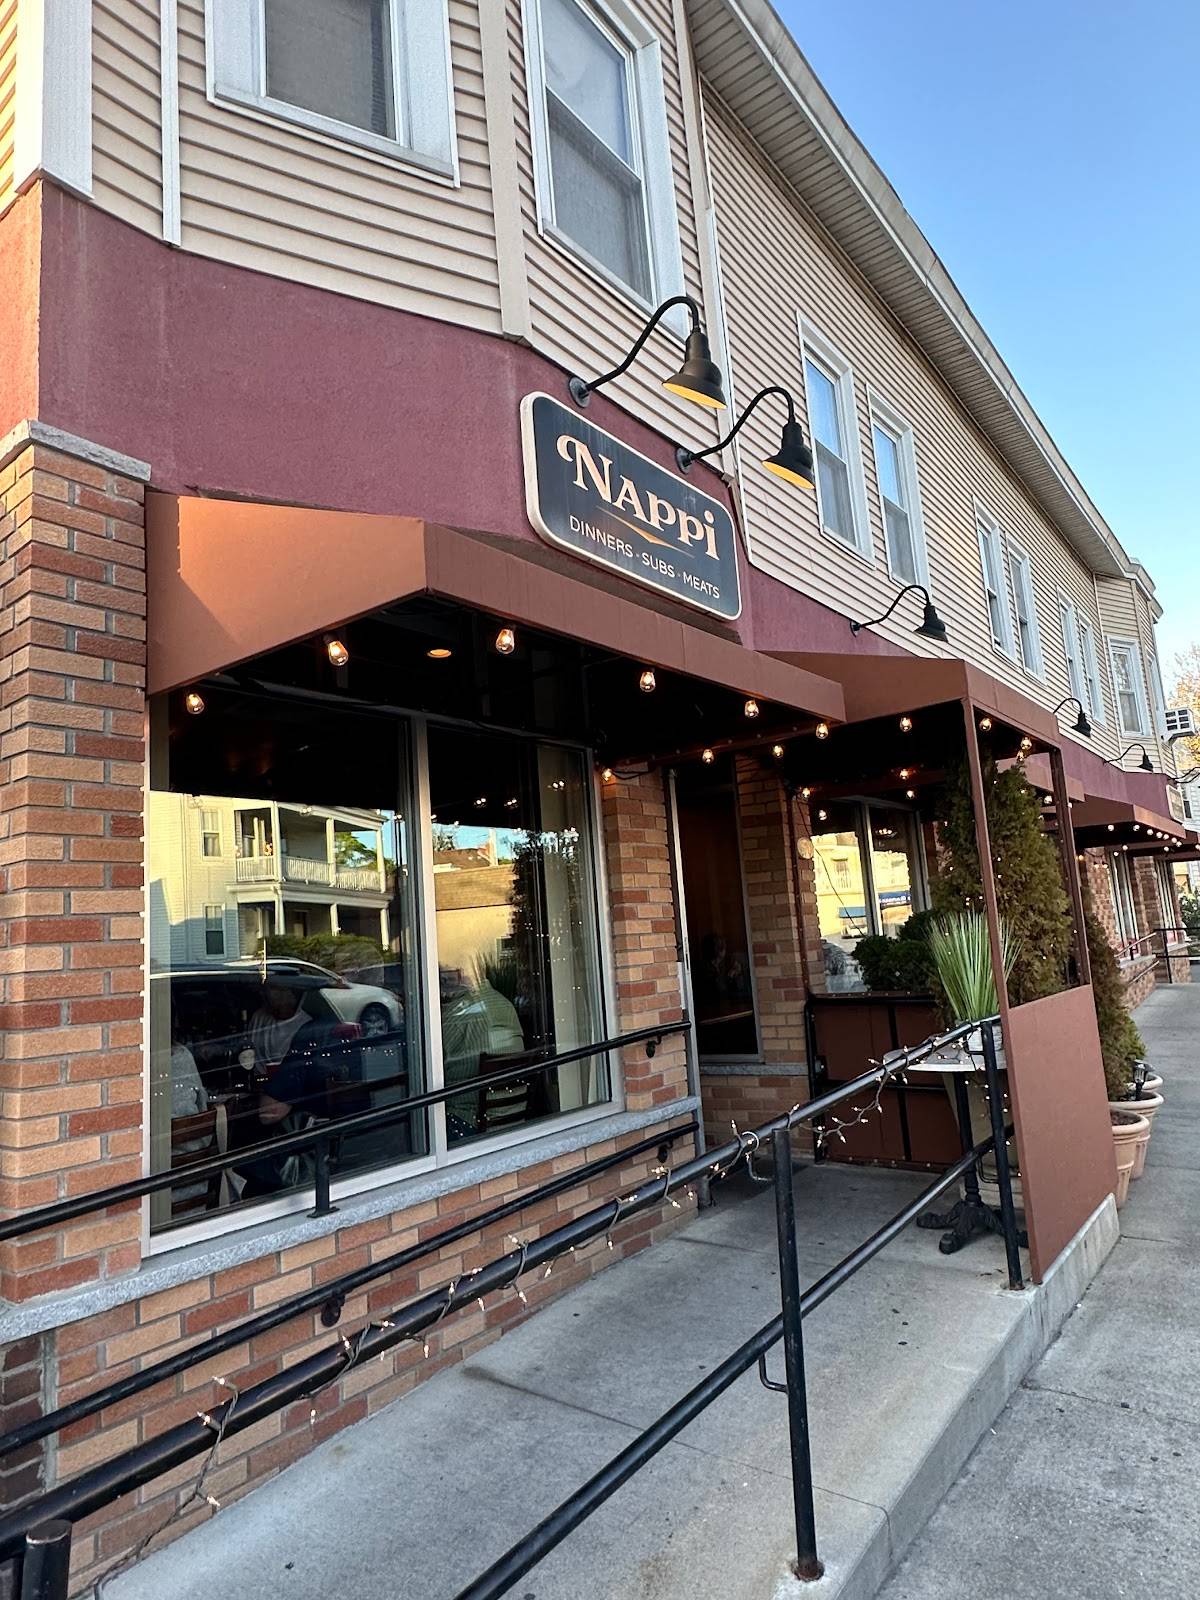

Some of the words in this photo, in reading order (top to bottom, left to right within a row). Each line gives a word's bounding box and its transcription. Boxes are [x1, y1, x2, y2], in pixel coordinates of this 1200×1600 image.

[569, 515, 633, 558] DINNERS
[642, 552, 675, 578] SUBS
[683, 571, 720, 599] MEATS
